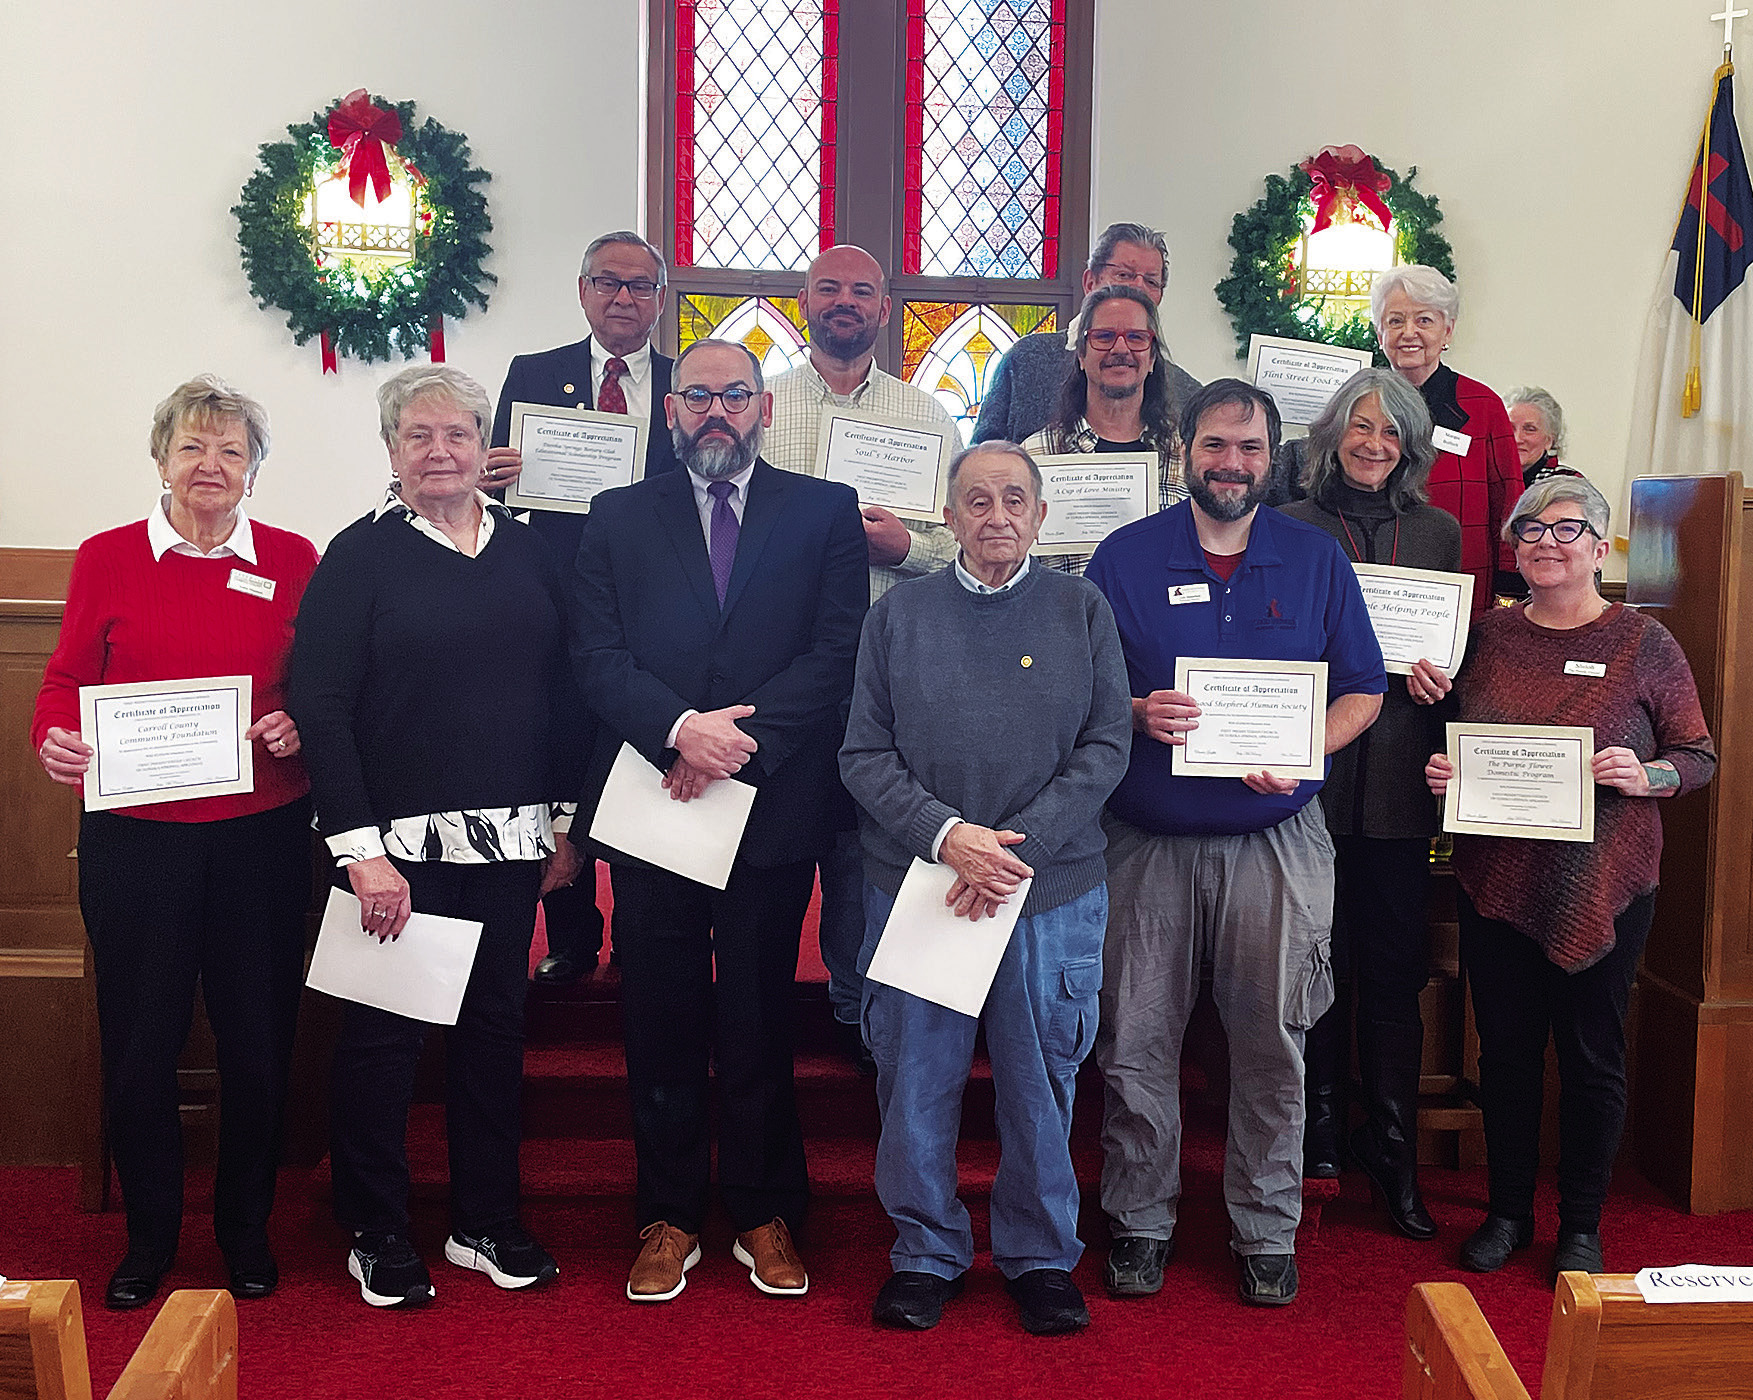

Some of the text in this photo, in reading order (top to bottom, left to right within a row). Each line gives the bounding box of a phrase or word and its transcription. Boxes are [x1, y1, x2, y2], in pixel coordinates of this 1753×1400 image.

[1272, 358, 1302, 367] Certificate
[1312, 363, 1348, 373] Appreciation
[1263, 370, 1283, 379] Flint
[1286, 372, 1309, 382] Street
[1312, 375, 1333, 385] Food
[537, 428, 570, 438] Certificate
[581, 432, 623, 442] Appreciation
[844, 432, 878, 442] Certificate
[888, 438, 927, 451] Appreciation
[883, 453, 915, 464] Harbor
[1102, 487, 1131, 496] Ministry
[1362, 587, 1391, 596] ertificate
[1403, 590, 1445, 601] Appreciation
[1381, 603, 1418, 616] Helping
[1420, 607, 1450, 619] People
[1204, 684, 1242, 692] Certificate
[1252, 685, 1298, 694] Appreciation
[114, 708, 157, 719] Certificate
[170, 703, 221, 715] Appreciation
[1215, 700, 1249, 709] Shepherd
[1281, 702, 1307, 712] Society
[137, 721, 199, 734] Carroll County
[120, 729, 217, 745] Community Foundation
[1474, 748, 1509, 756] Certificate
[1521, 749, 1566, 758] Appreciation
[1502, 762, 1526, 770] Purple
[1528, 762, 1553, 770] Flower
[1487, 769, 1554, 779] Domestic Program
[1650, 1271, 1753, 1287] Reserve
